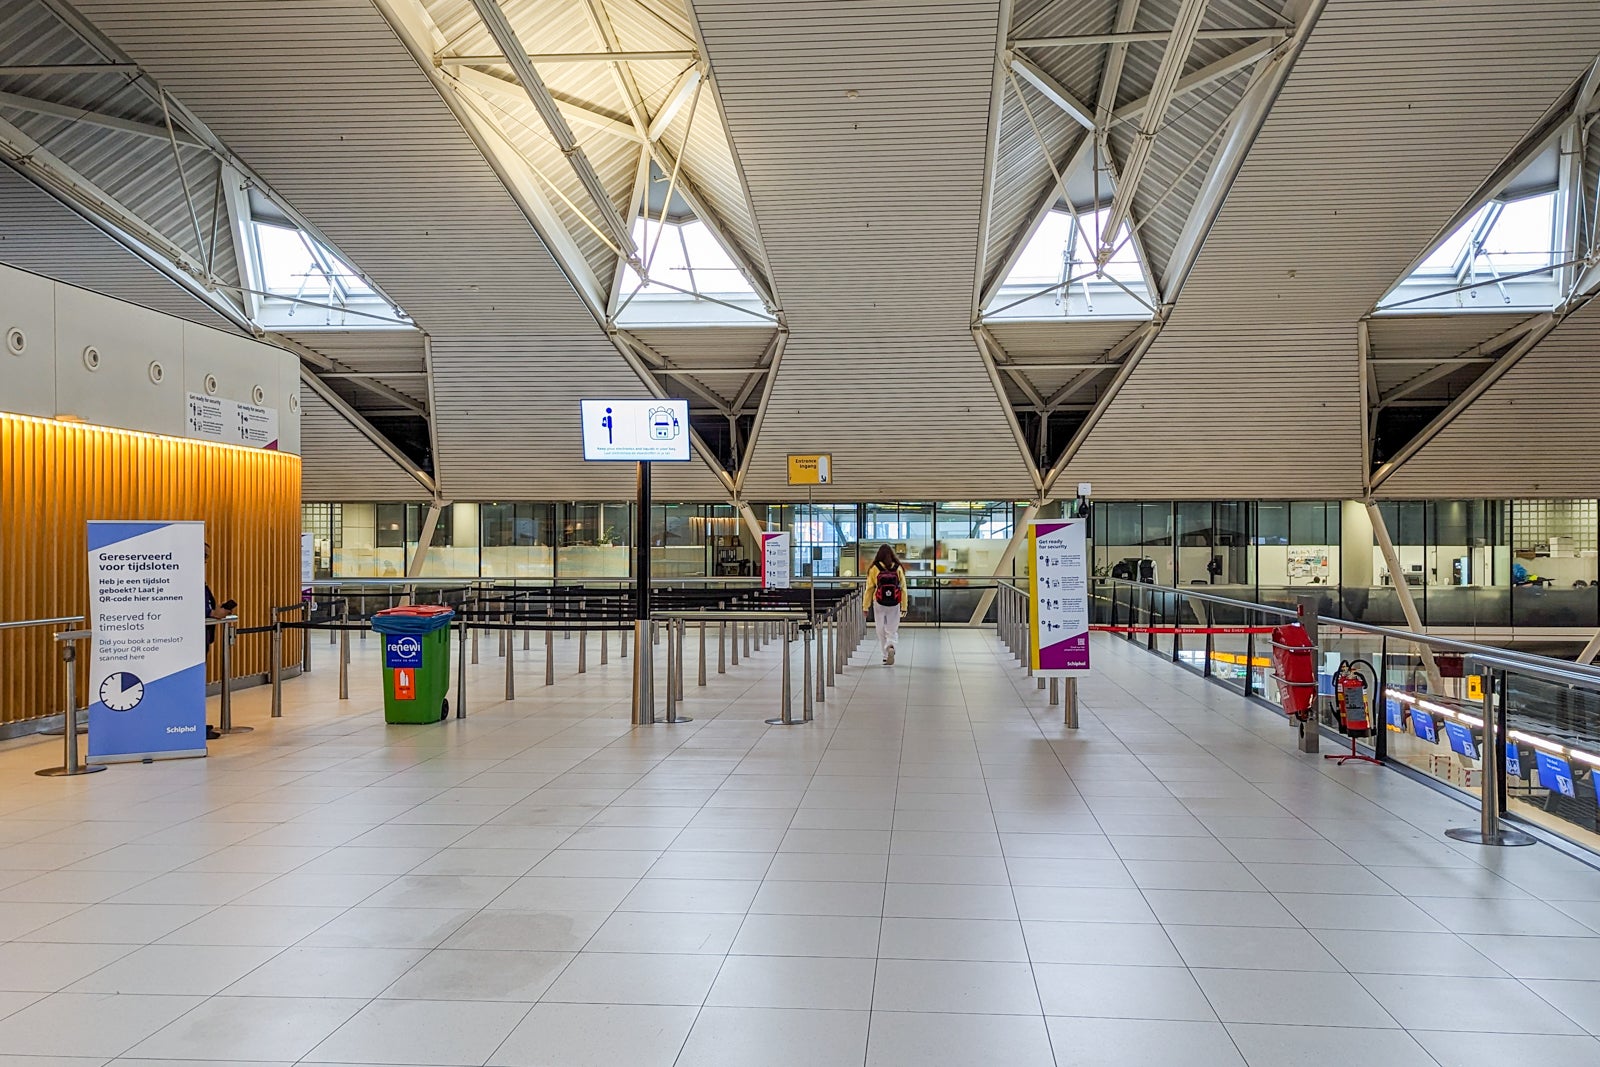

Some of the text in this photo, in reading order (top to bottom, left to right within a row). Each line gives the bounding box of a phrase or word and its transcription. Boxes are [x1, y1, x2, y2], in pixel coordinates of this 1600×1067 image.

[99, 552, 172, 560] Gereserveerd
[128, 562, 179, 572] tijdsloten
[99, 587, 136, 595] geboekt?
[100, 612, 161, 621] Reserved for
[99, 623, 144, 631] timeslots
[387, 642, 420, 651] renewi
[166, 725, 196, 734] Schiphol
